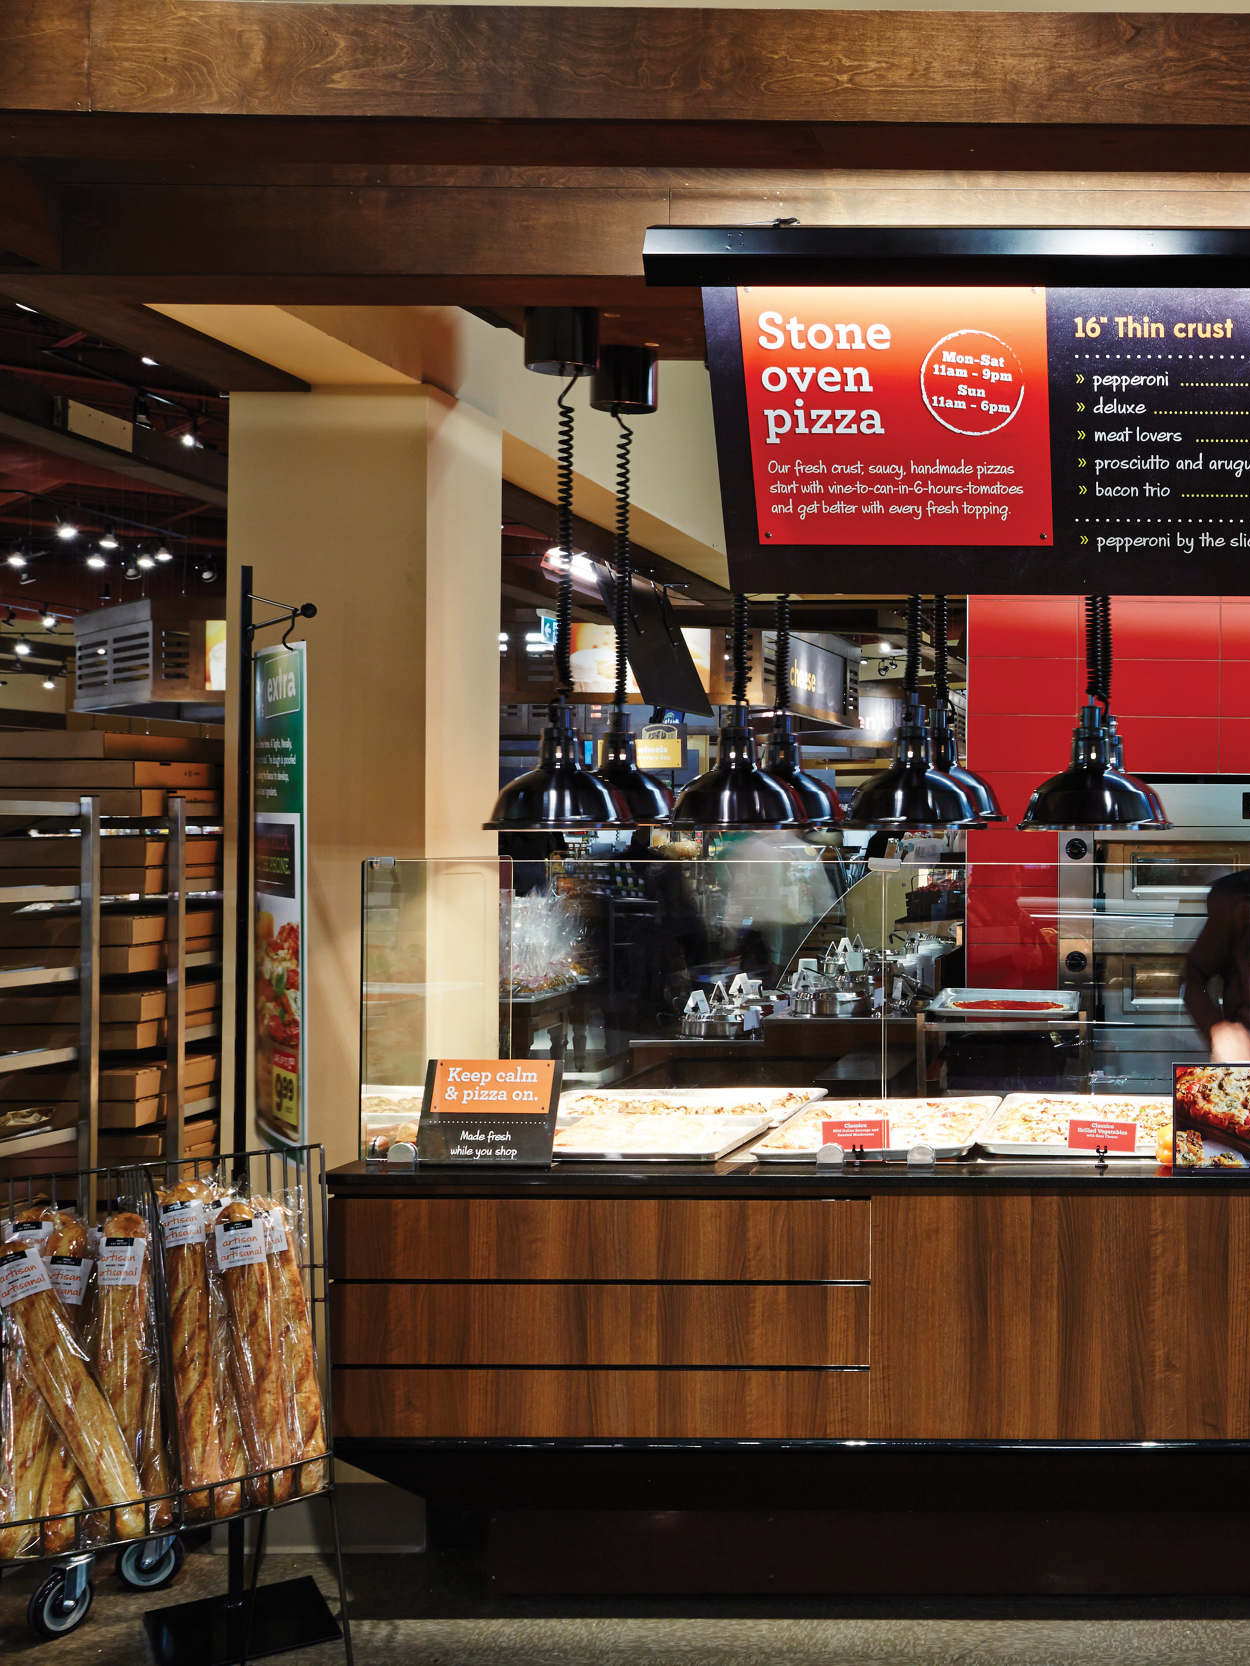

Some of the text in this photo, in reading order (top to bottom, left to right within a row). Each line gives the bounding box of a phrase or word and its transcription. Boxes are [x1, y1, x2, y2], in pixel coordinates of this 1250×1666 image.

[758, 312, 891, 350] Stone
[1115, 316, 1165, 338] Thin
[1173, 319, 1233, 338] crust
[762, 366, 873, 392] oven
[933, 364, 968, 377] 11am
[982, 369, 1012, 382] 9pm
[1093, 372, 1169, 392] pepperoni
[958, 385, 985, 397] Sun
[932, 396, 966, 409] 11am
[981, 401, 1010, 414] 6pm
[1093, 396, 1147, 414] deluxe
[764, 398, 885, 444] pizza
[1094, 427, 1131, 442] meat
[1137, 427, 1182, 442] lovers
[768, 459, 1014, 480] Our fresh crust, saucy, handmade pizzas
[1095, 455, 1170, 475] prosciutto
[1176, 453, 1202, 469] and
[769, 480, 1024, 495] start with vine-to-can-in-6-hours-tomatoes
[1095, 482, 1138, 497] bacon
[1144, 482, 1170, 496] trio
[772, 499, 1011, 520] and get better with every fresh topping.
[1097, 534, 1170, 552] pepperoni
[1177, 532, 1194, 553] by
[1199, 532, 1225, 547] the
[790, 658, 816, 692] cheese
[267, 669, 296, 703] extra
[448, 1066, 537, 1086] Keep calm
[445, 1086, 538, 1104] & pizza on.
[460, 1130, 511, 1143] Made fresh
[450, 1146, 517, 1159] while you shop
[222, 1236, 257, 1247] artisan
[221, 1247, 262, 1262] artisanal
[1, 1274, 45, 1297] artisanal
